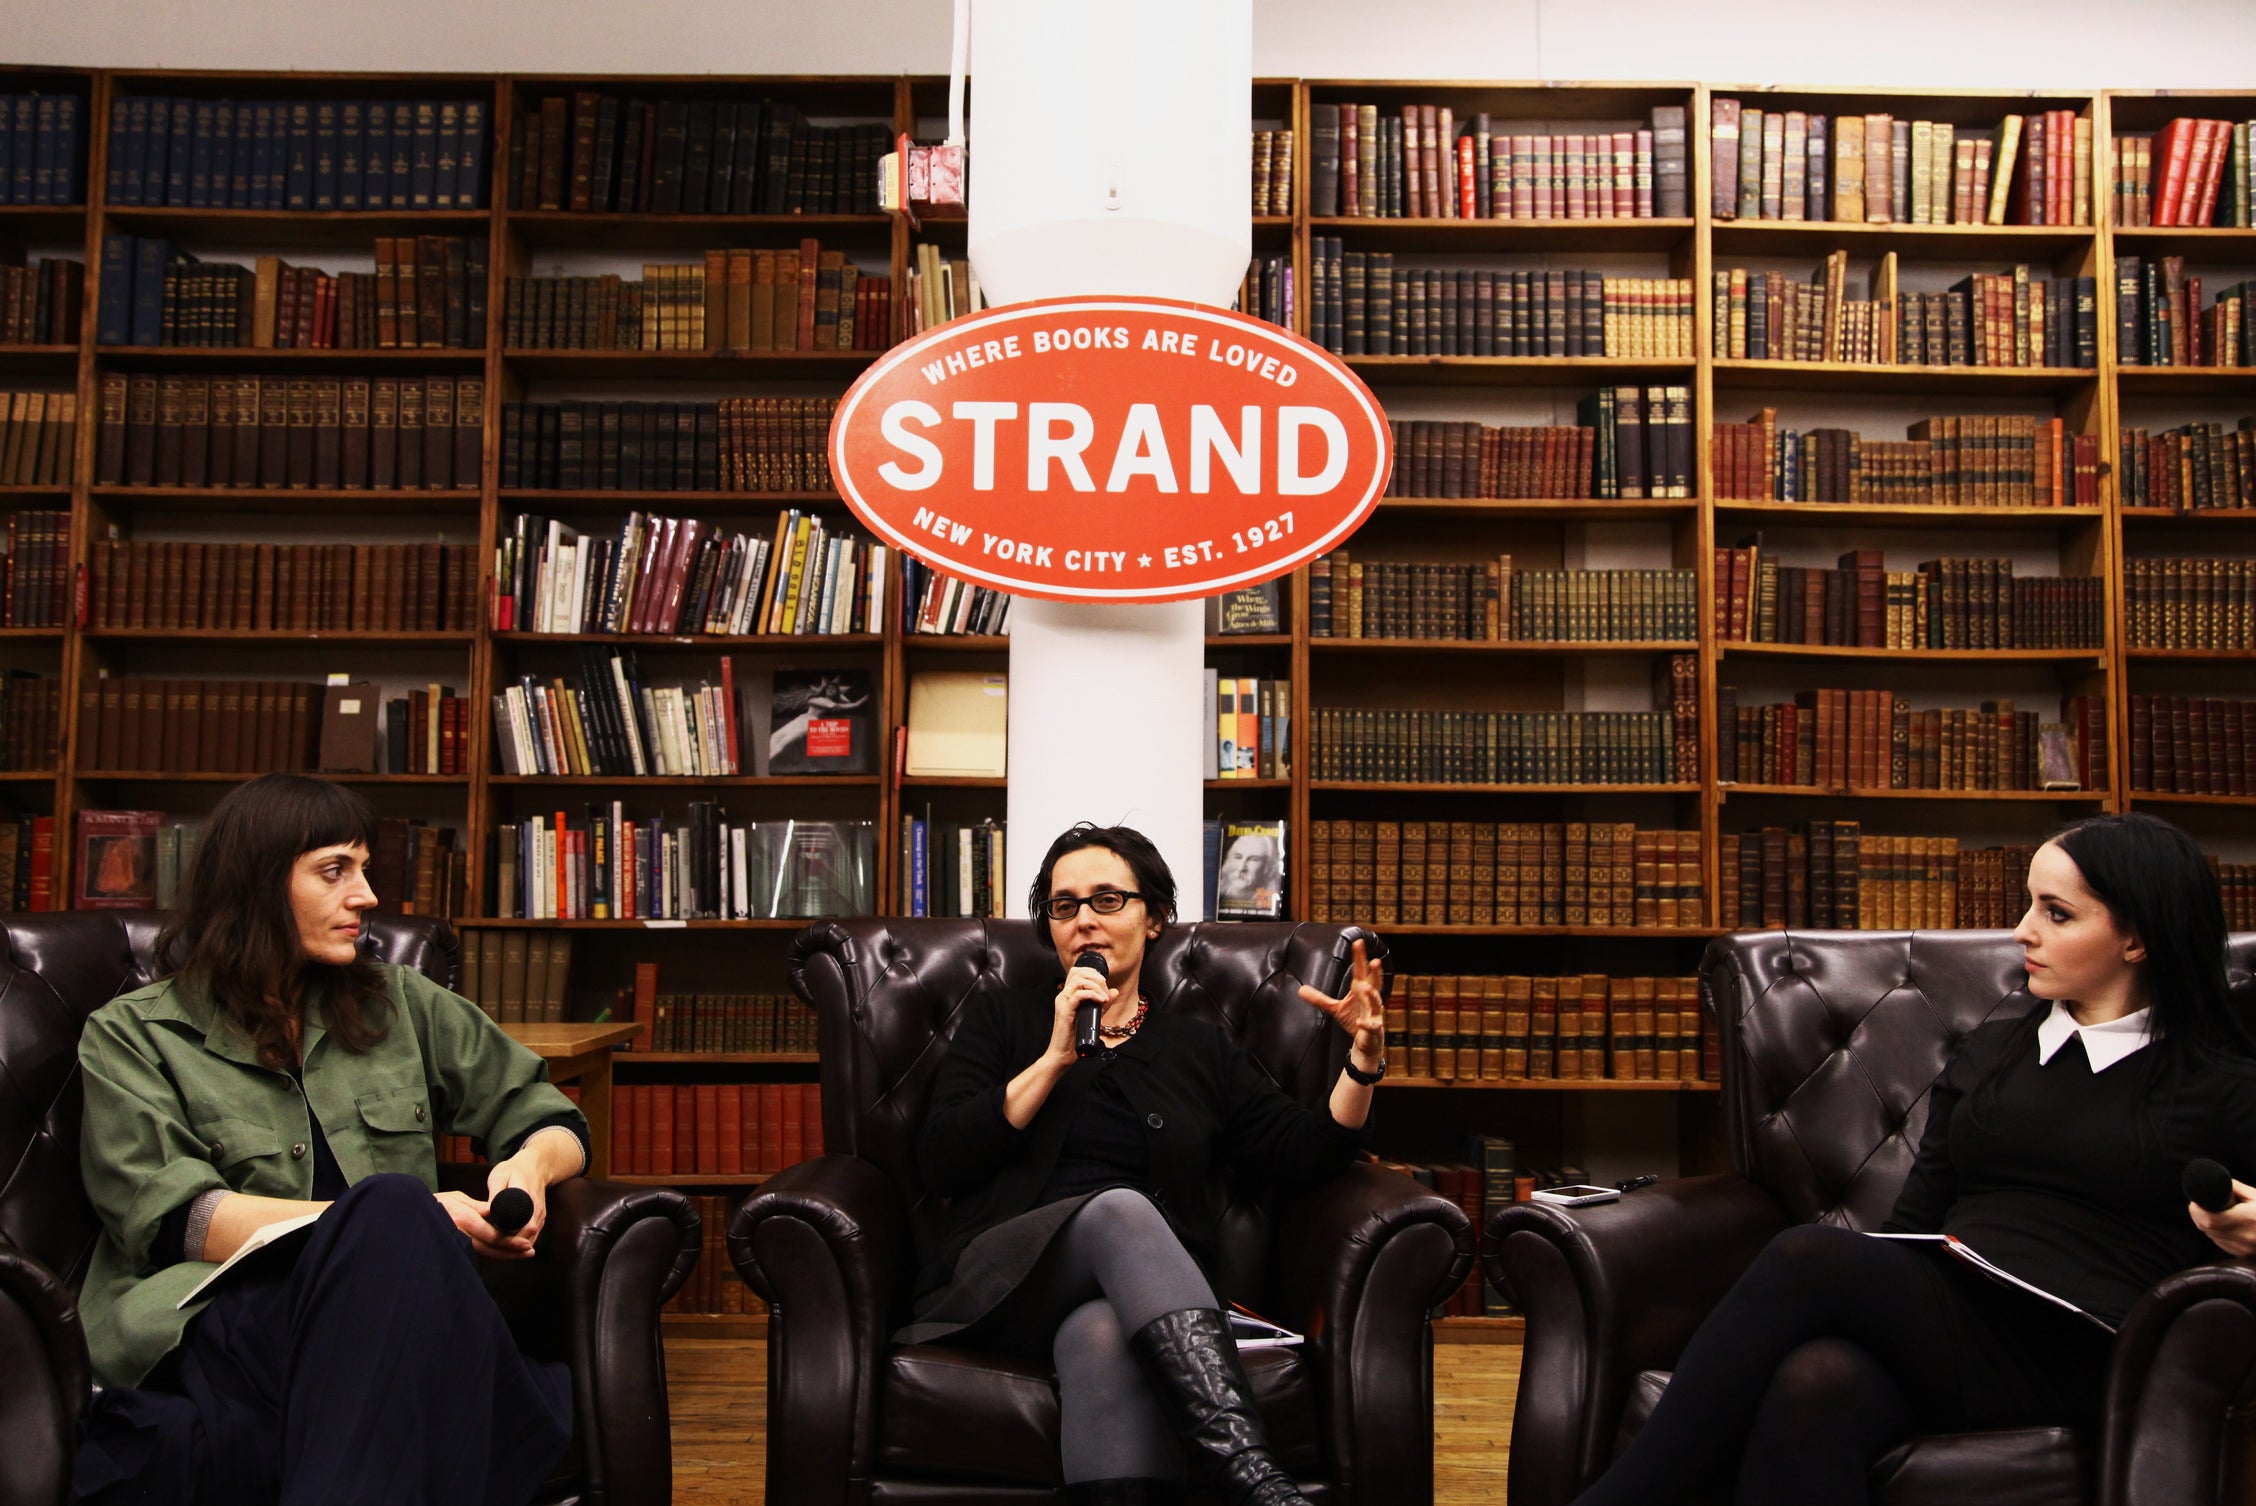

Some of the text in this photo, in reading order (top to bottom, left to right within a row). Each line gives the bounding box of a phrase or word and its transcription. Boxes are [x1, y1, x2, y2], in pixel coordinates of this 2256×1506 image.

[919, 326, 1298, 388] WHERE BOOKS ARE LOVED
[877, 400, 1349, 497] STRAND
[912, 506, 1294, 573] NEW YORK CITY EST. 1927
